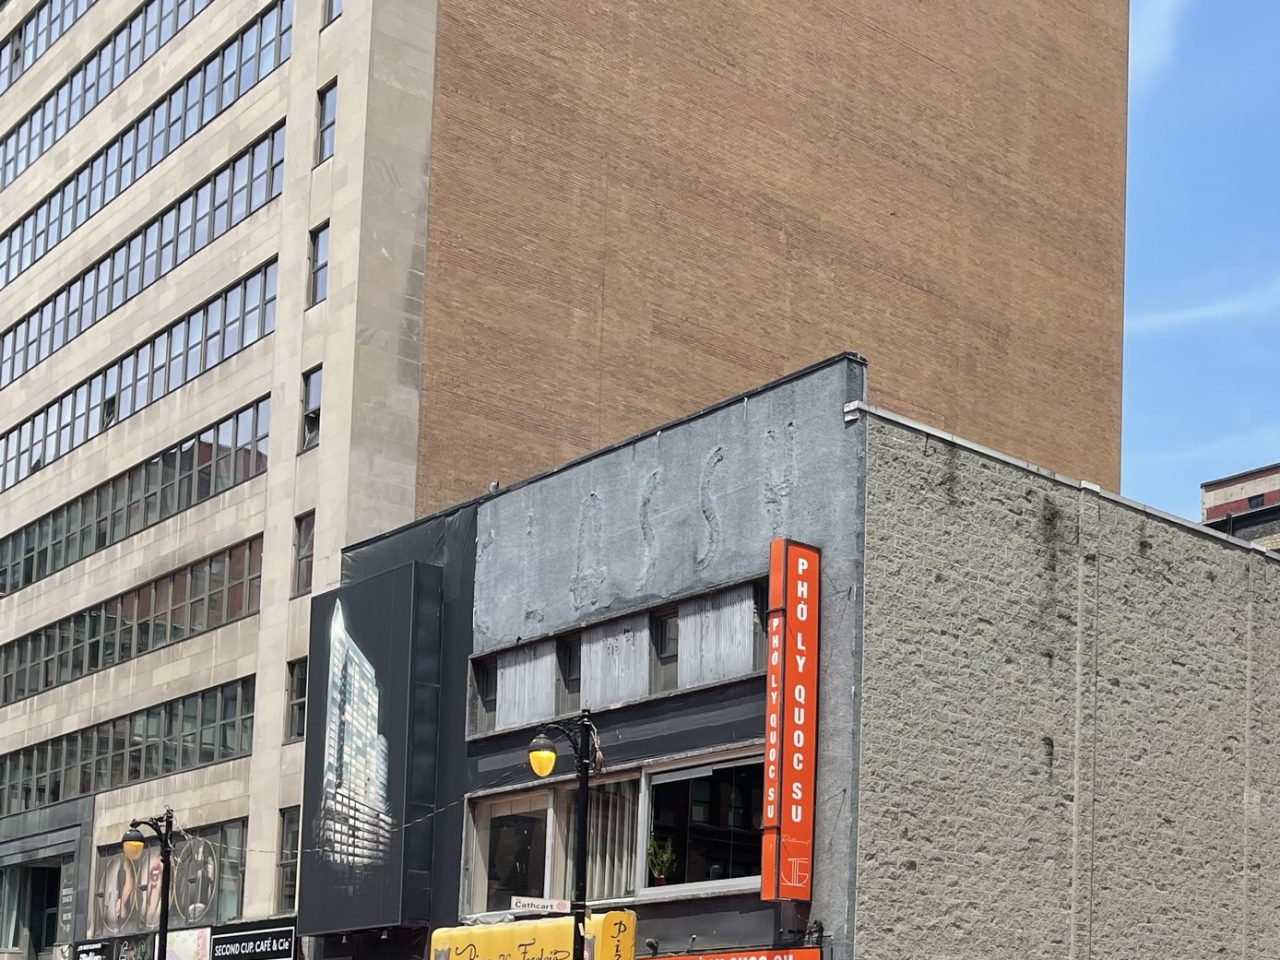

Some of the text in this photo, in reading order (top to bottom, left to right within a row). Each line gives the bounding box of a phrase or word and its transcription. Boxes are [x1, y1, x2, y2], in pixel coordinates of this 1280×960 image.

[795, 632, 806, 673] LY
[770, 674, 777, 705] LY
[792, 684, 806, 771] QUOC
[768, 713, 777, 779] QUOC
[767, 787, 774, 819] SU
[791, 782, 803, 823] SU
[515, 901, 554, 910] Cathcart
[215, 942, 240, 956] SECOND
[255, 937, 271, 953] CAFÉ
[272, 940, 278, 950] &
